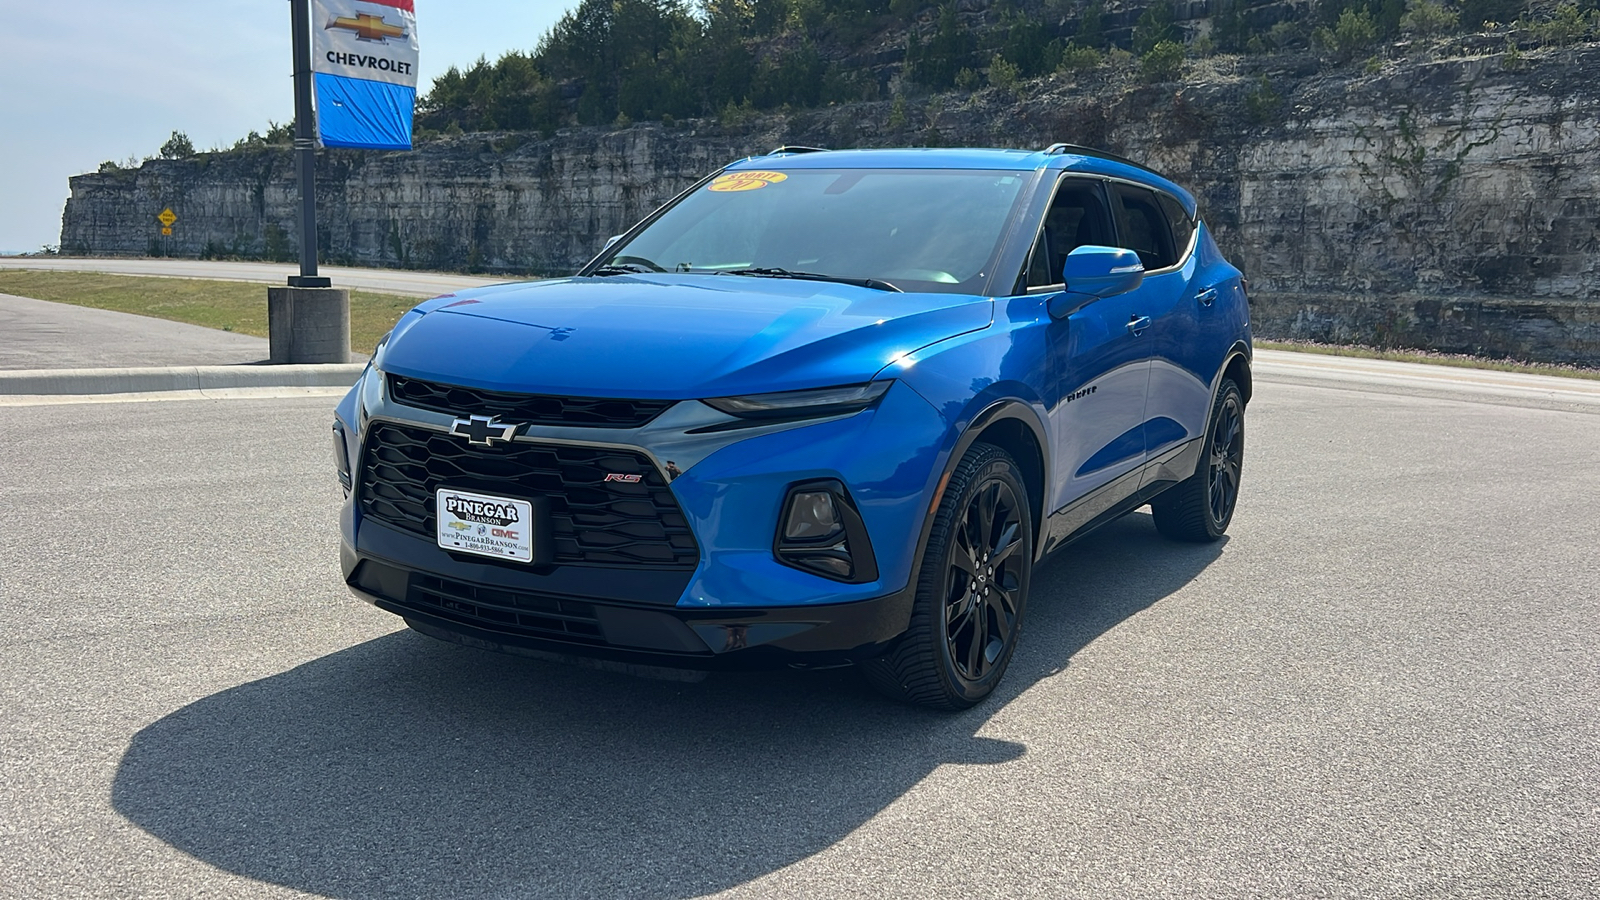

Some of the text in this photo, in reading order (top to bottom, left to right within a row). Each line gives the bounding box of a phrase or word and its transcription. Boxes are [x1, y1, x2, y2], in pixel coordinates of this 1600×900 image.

[326, 51, 412, 75] CHEVROLET
[728, 172, 781, 180] SPORTY
[604, 473, 642, 483] RS
[447, 498, 518, 521] PINEGAR
[466, 512, 501, 526] BRANSON
[492, 528, 519, 540] GMC
